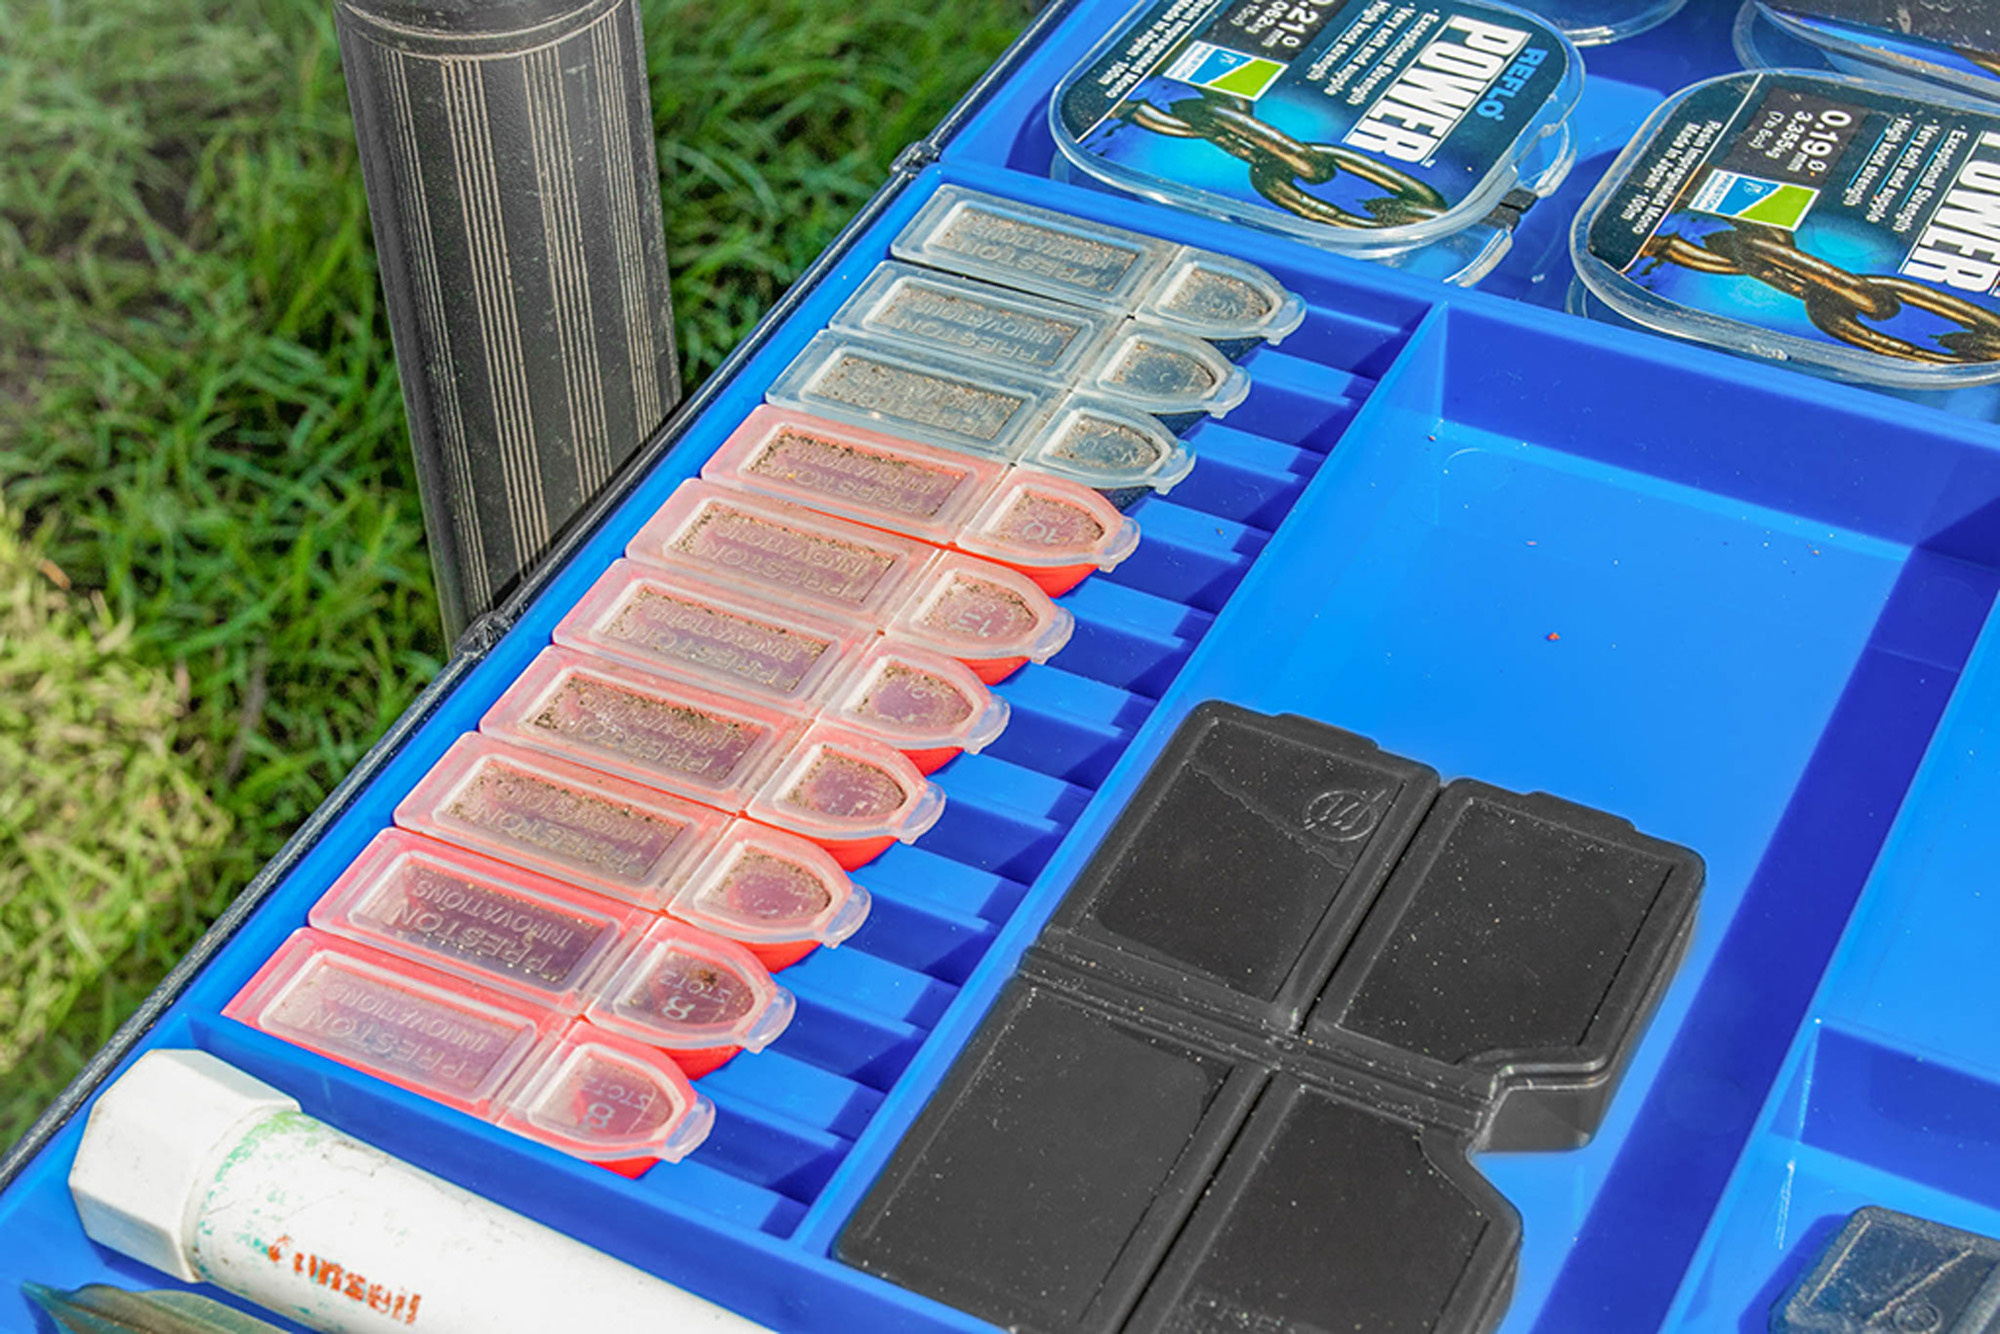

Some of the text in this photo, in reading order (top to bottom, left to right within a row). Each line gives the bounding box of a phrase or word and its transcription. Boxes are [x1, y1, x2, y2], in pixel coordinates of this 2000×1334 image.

[1127, 30, 1159, 56] Japan
[1130, 20, 1190, 74] Impregnated
[1279, 0, 1334, 34] .21
[1306, 0, 1391, 80] High knot strength
[1098, 61, 1129, 85] 100m
[1324, 8, 1416, 95] Very soft and supple
[1347, 13, 1440, 105] Exceptional Strength
[1105, 72, 1138, 98] Mono
[1345, 15, 1527, 163] POWER
[1672, 123, 1701, 148] Made
[1693, 120, 1722, 147] Resin
[1787, 110, 1852, 171] 0.19 mm
[1843, 118, 1912, 206] High knot strength
[1644, 158, 1674, 188] Japan
[1648, 147, 1703, 207] Impregnated
[1702, 173, 1734, 211] PRESTON
[1866, 125, 1940, 222] Very soft and supple
[1893, 130, 1968, 232] Exceptional Strength
[1621, 194, 1649, 220] 100m
[1632, 206, 1662, 234] Mono
[397, 901, 553, 974] PRESTON
[416, 878, 573, 950] INNOVATIONS
[308, 1006, 469, 1079] PRESTON
[327, 982, 492, 1054] INNOVATIONS
[579, 1101, 617, 1131] 8
